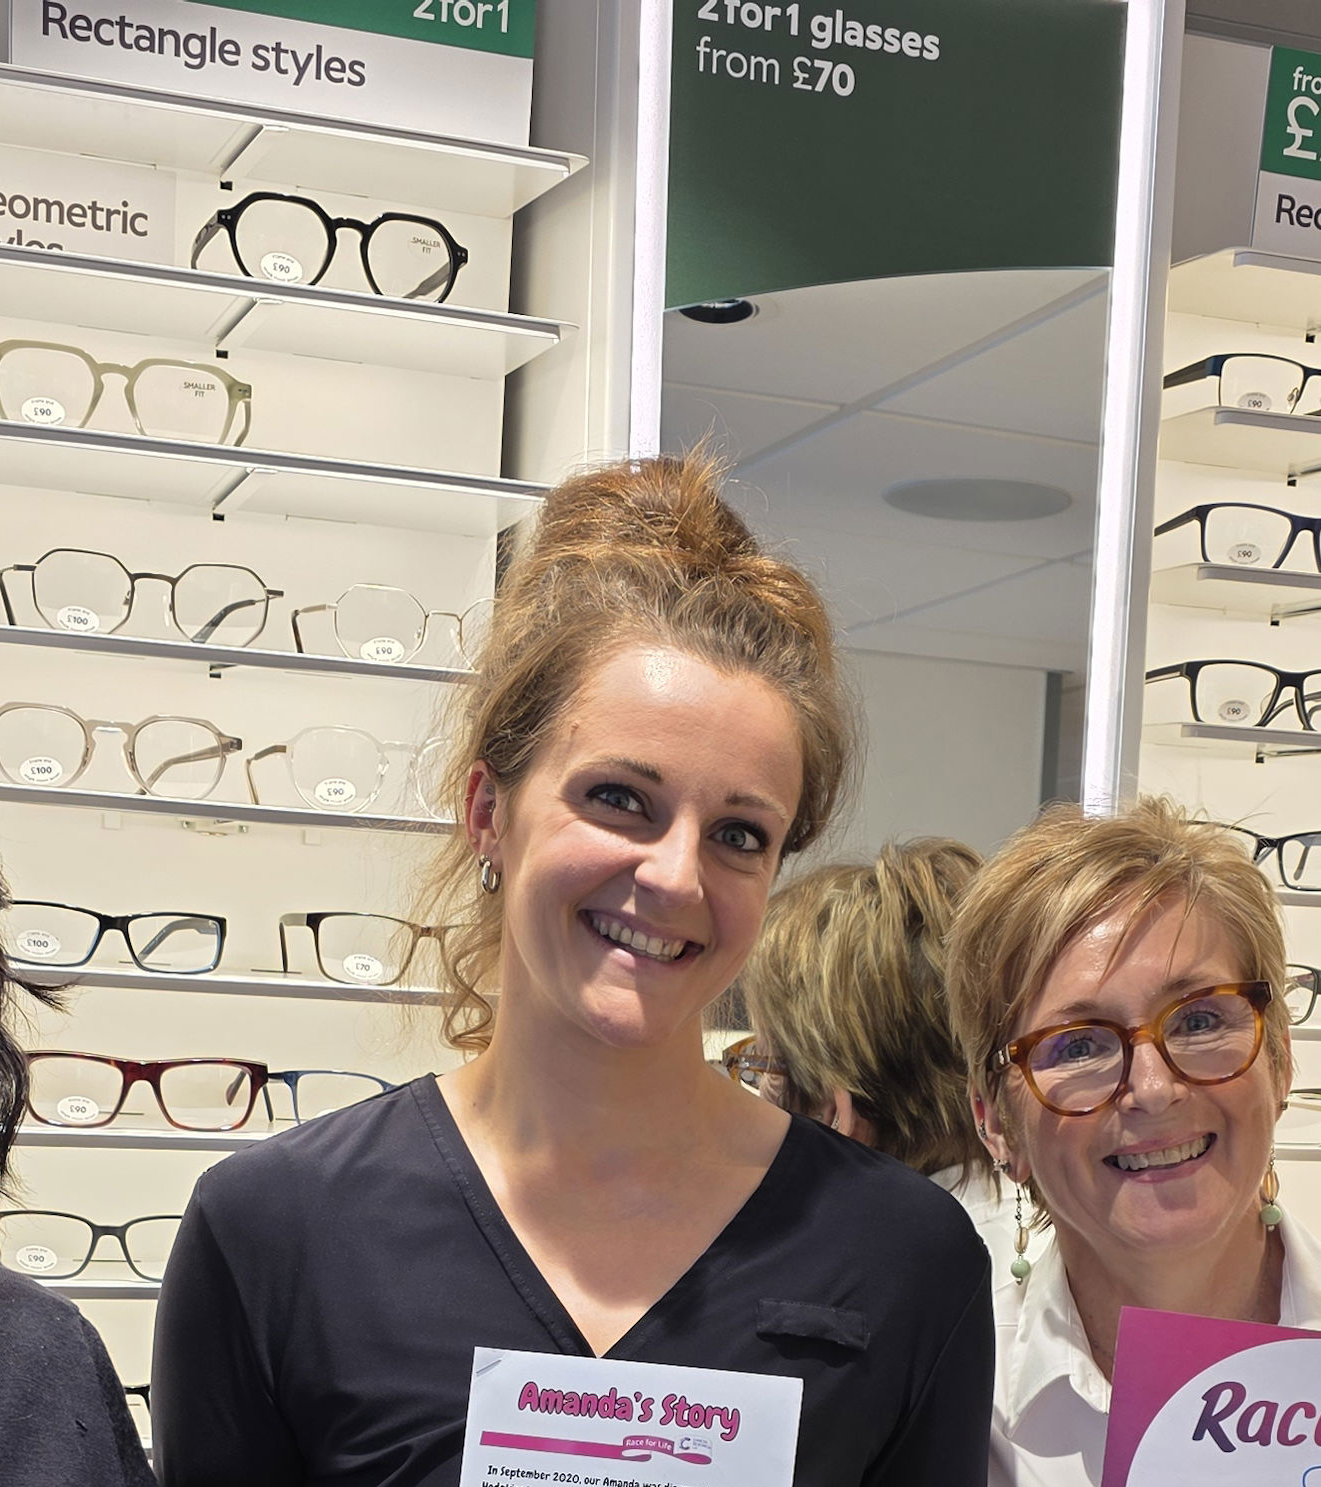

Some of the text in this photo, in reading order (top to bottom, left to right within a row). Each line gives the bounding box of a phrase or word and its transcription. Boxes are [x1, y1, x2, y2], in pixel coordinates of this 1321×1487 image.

[42, 0, 366, 87] Rectangle styles
[810, 9, 940, 61] glasses
[696, 36, 856, 97] from £70
[273, 262, 290, 273] £90
[33, 408, 52, 417] £90
[517, 1380, 740, 1441] Amanda's Story
[626, 1438, 672, 1451] Race for Life
[487, 1464, 498, 1475] In
[499, 1465, 550, 1480] September
[552, 1471, 581, 1484] 2020,
[583, 1476, 600, 1485] our
